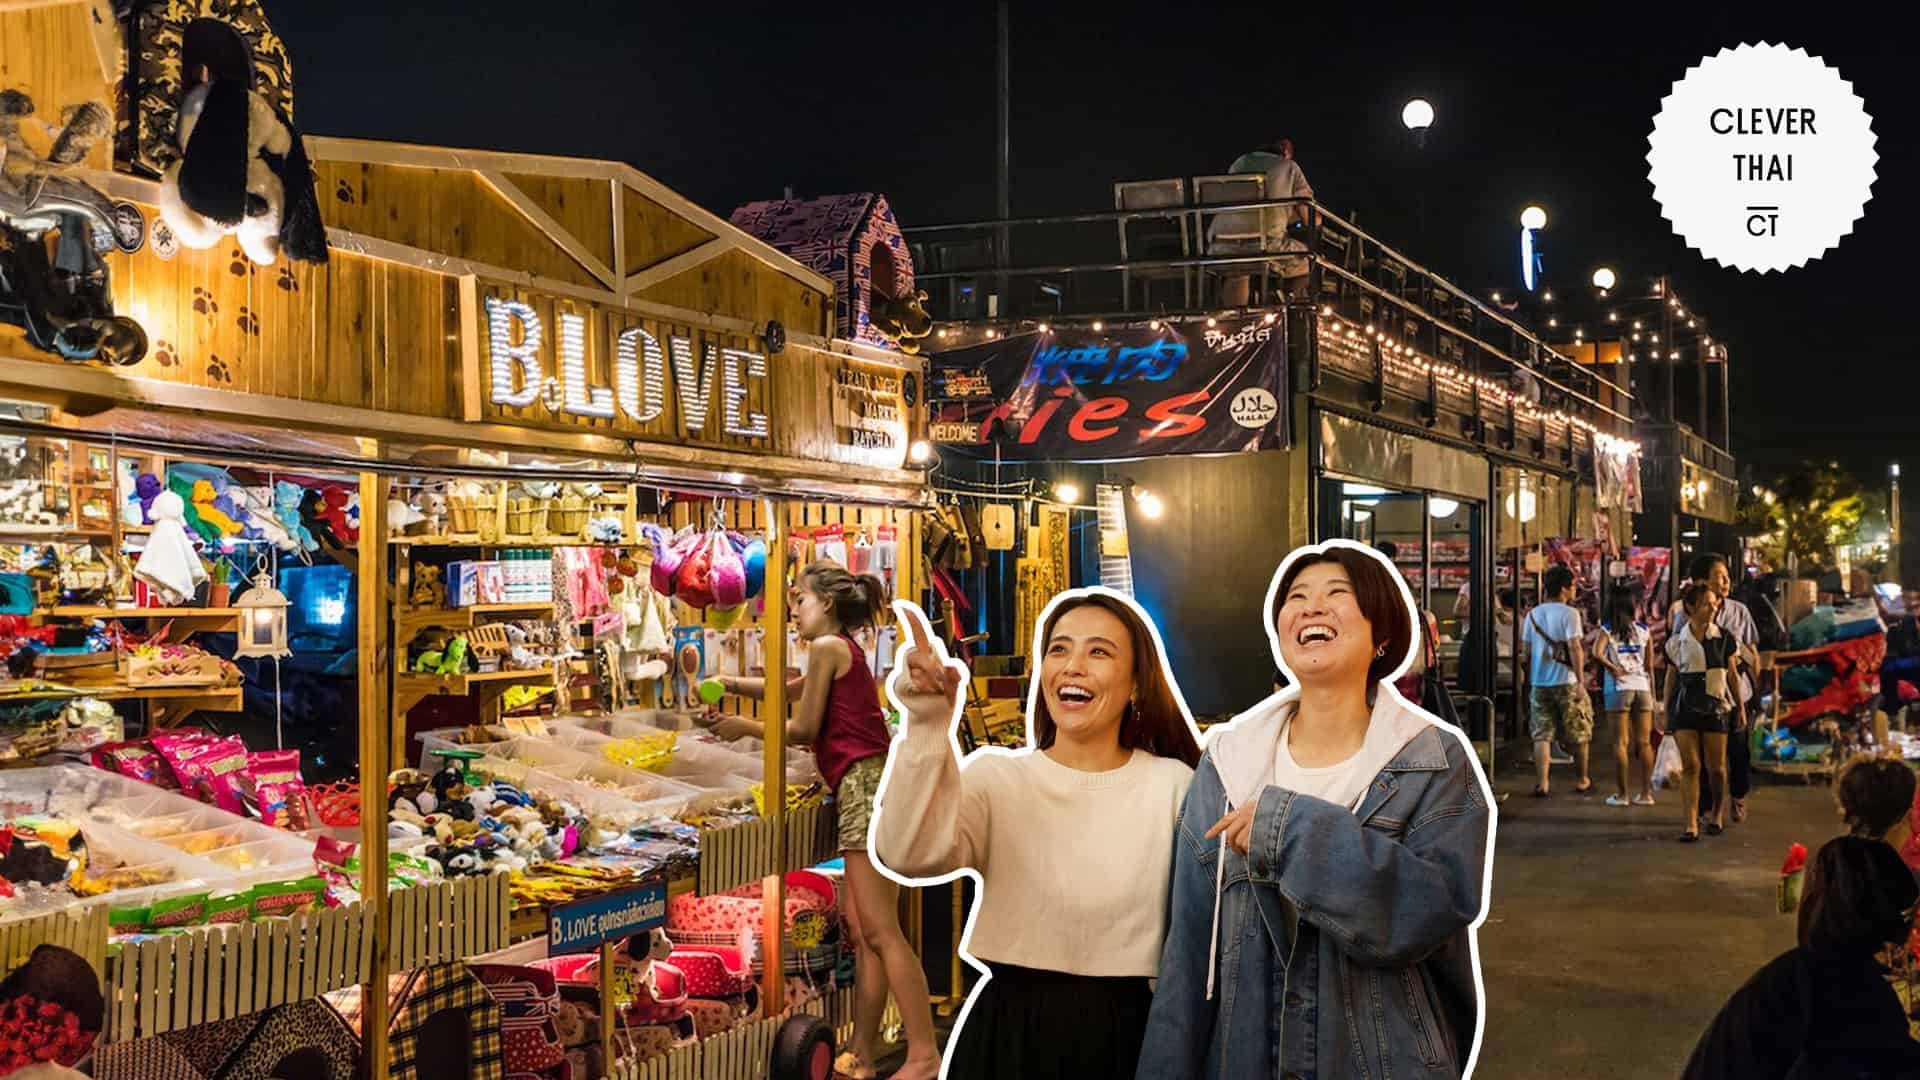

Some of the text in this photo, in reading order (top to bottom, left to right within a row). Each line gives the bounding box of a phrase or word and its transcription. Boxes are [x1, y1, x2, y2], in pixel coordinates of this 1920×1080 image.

[486, 296, 769, 438] B.LOVE
[1232, 394, 1275, 413] حلال
[1236, 413, 1269, 422] HALAL
[928, 422, 978, 443] WELCOME
[551, 912, 597, 946] B.LOVE
